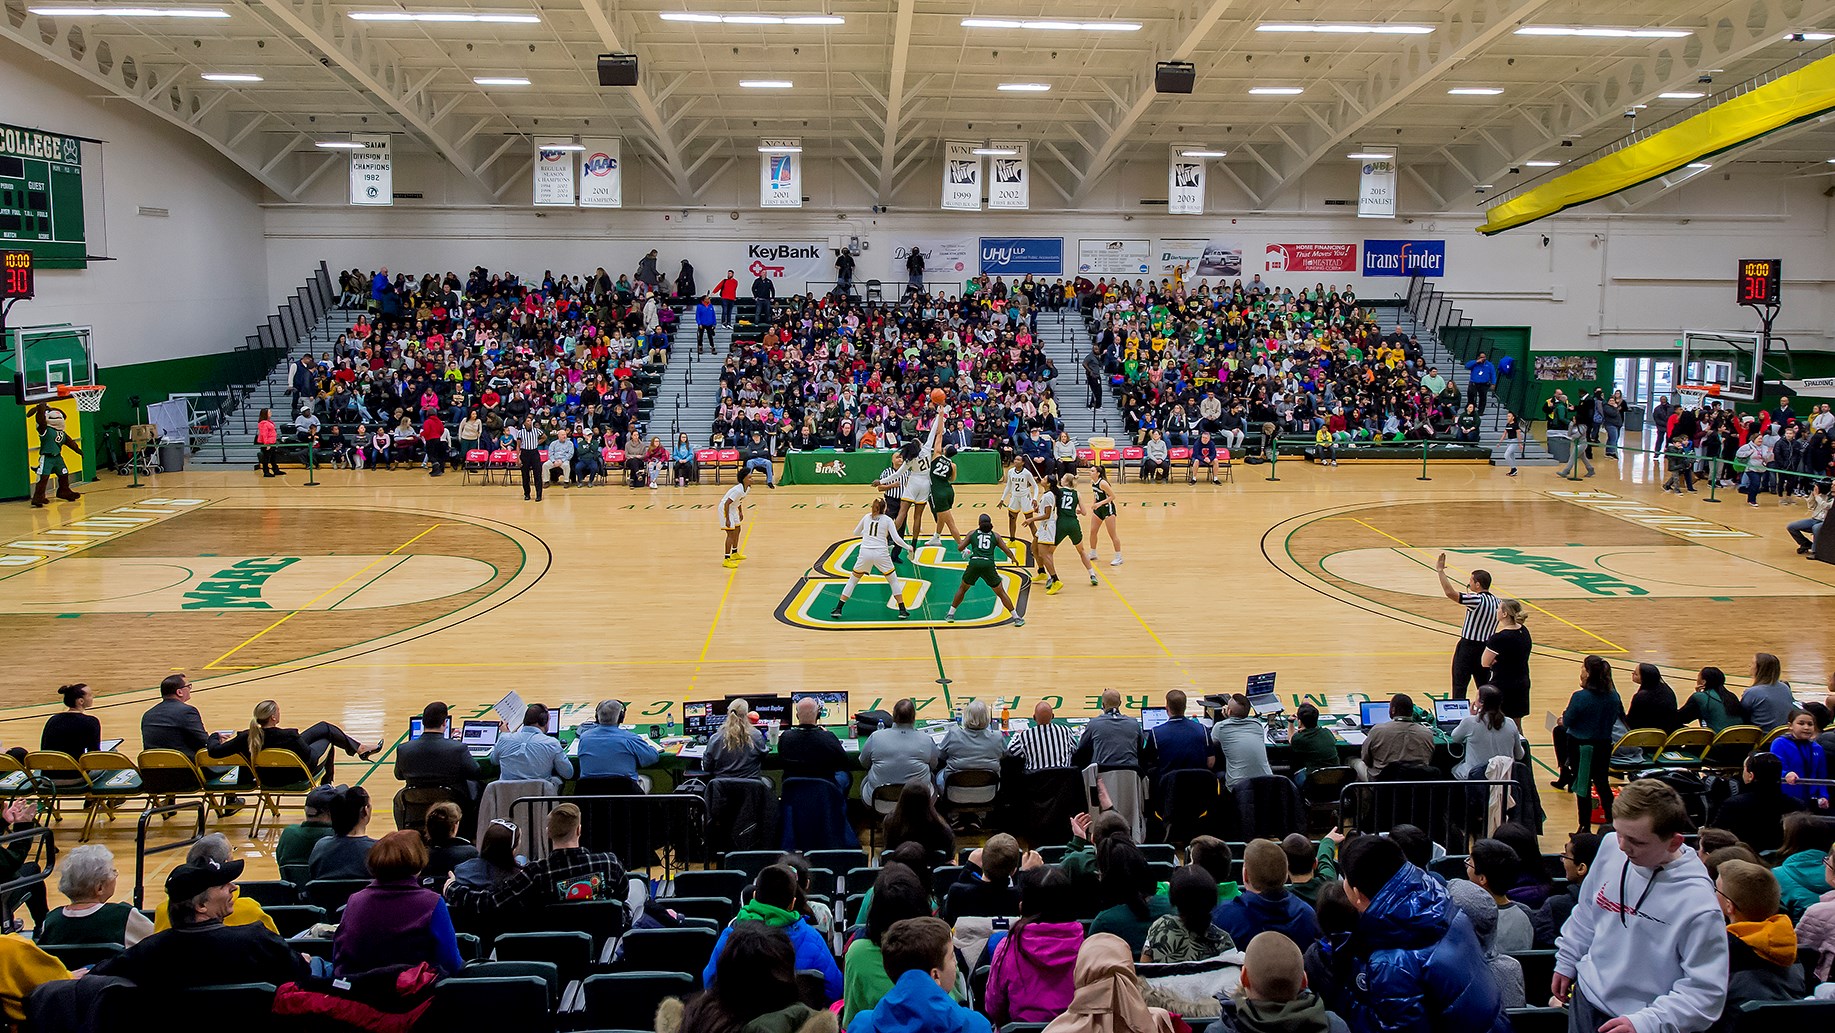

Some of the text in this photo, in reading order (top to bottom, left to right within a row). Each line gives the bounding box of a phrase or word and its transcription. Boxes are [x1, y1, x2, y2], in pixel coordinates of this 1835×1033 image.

[0, 127, 61, 160] COLLEGE
[28, 181, 45, 191] GUEST
[953, 191, 972, 199] 1999
[998, 190, 1019, 199] 2002
[1177, 194, 1196, 203] 2003
[748, 244, 820, 261] KeyBank
[983, 247, 1012, 265] UHY
[1366, 243, 1442, 274] transfinder
[6, 254, 30, 268] 10:00
[1745, 263, 1769, 277] 10:00
[7, 269, 28, 293] 30
[1745, 277, 1766, 300] 30
[1803, 379, 1834, 388] SPALDING
[918, 457, 930, 471] 21
[932, 461, 950, 477] 22
[1015, 483, 1020, 492] 2
[1061, 495, 1073, 510] 12
[869, 521, 879, 537] 11
[977, 534, 991, 549] 15
[1441, 548, 1650, 596] MAAC
[181, 557, 302, 610] MAAC
[771, 705, 785, 713] Replay
